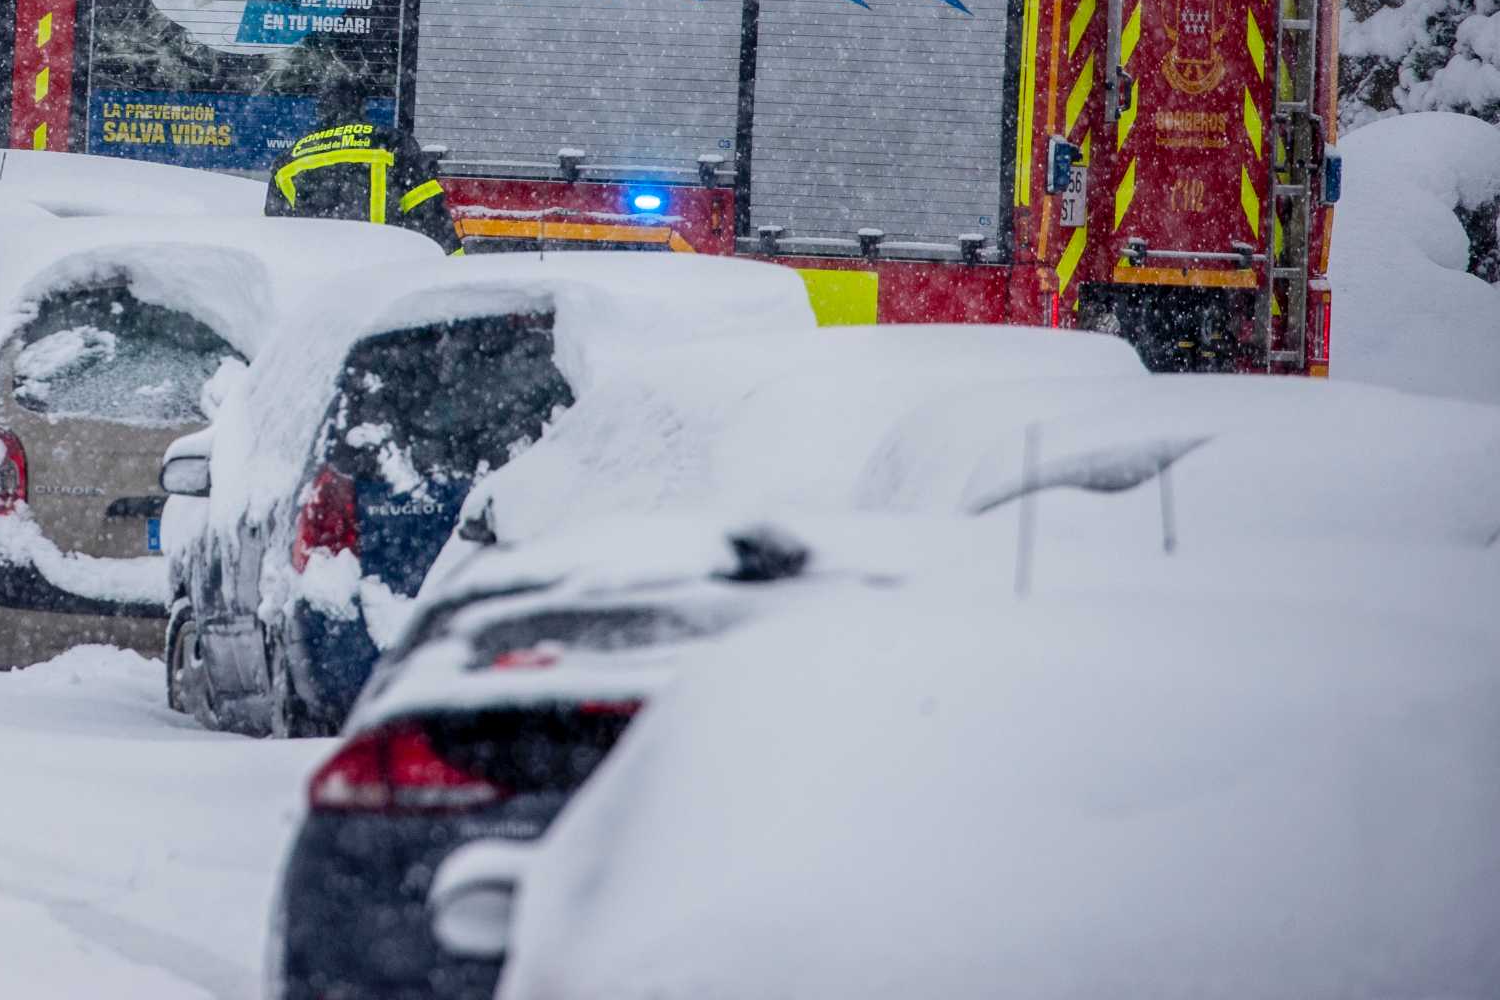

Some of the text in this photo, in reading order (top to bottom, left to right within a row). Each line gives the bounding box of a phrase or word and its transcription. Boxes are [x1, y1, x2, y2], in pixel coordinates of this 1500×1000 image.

[263, 13, 372, 35] EN TU HOGAR!
[103, 103, 122, 119] LA
[103, 120, 233, 147] SALVA VIDAS
[368, 502, 445, 516] PEUGEOT
